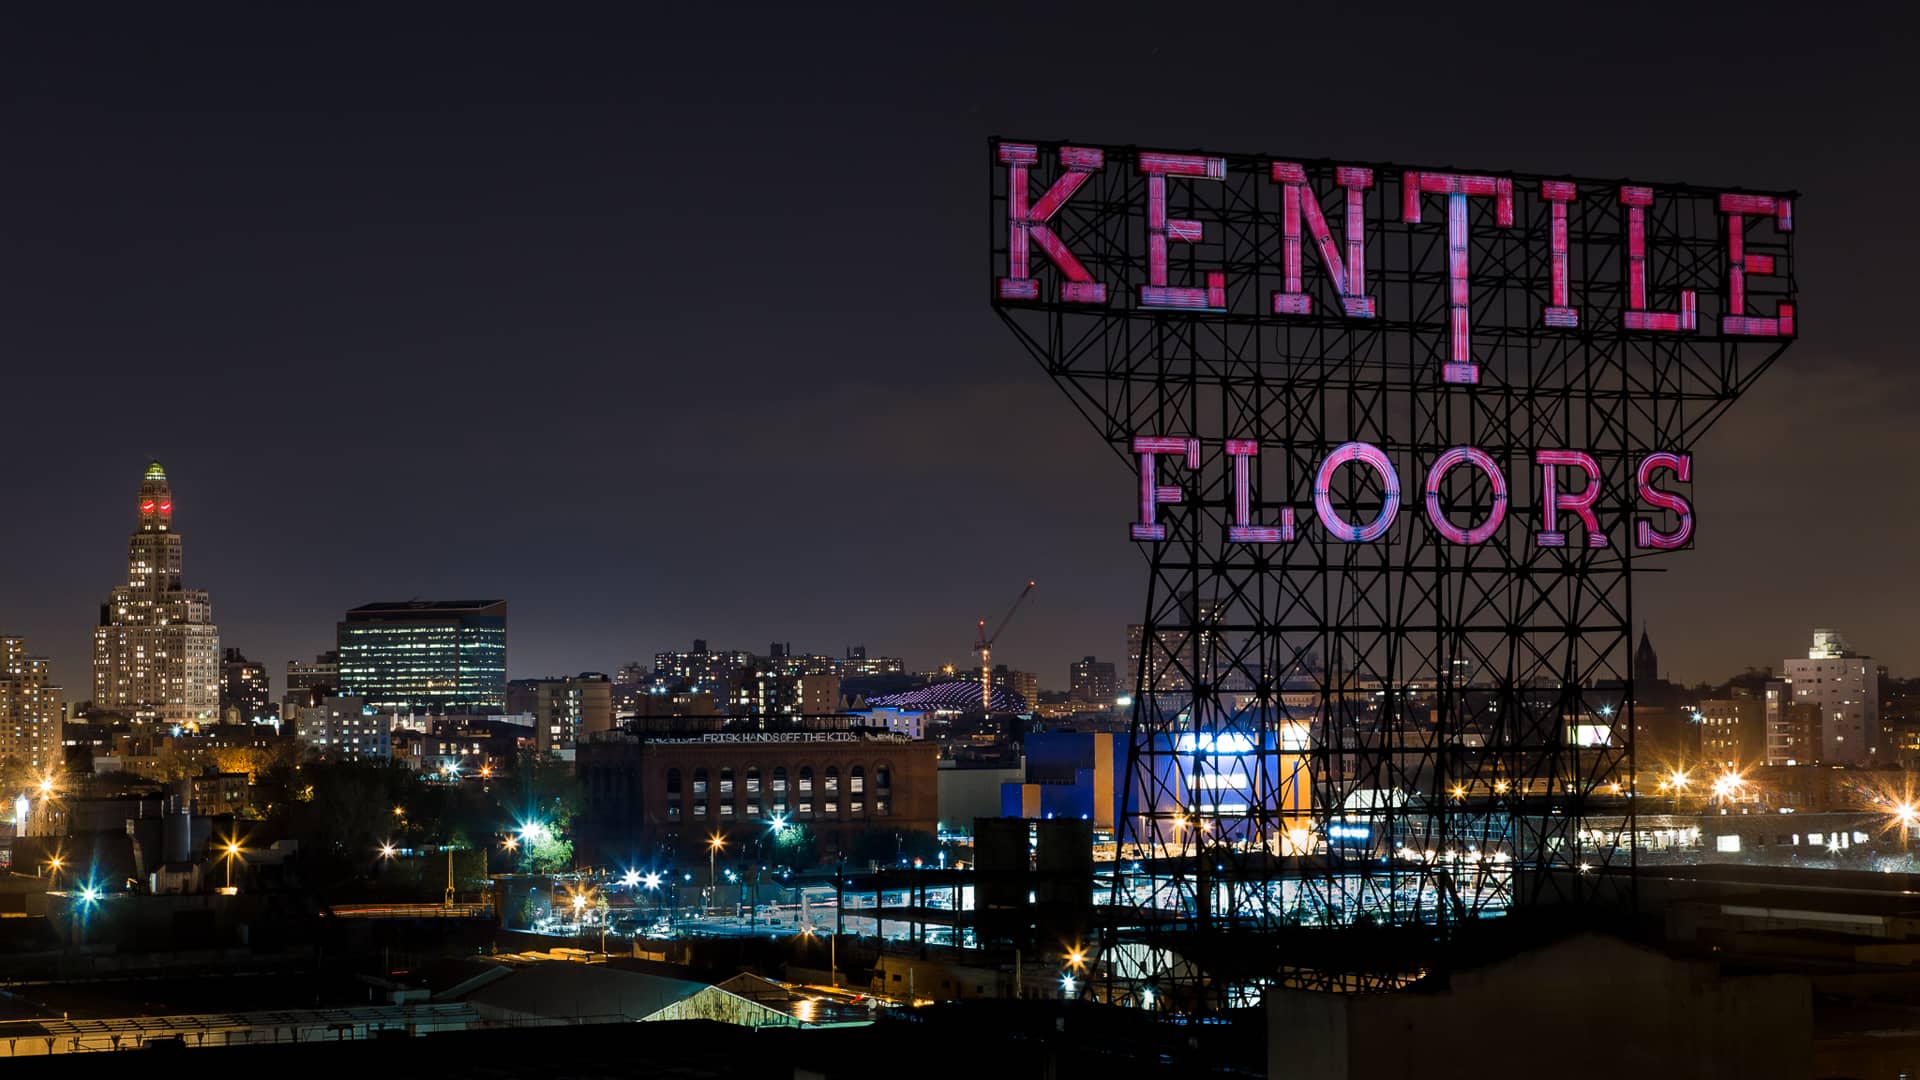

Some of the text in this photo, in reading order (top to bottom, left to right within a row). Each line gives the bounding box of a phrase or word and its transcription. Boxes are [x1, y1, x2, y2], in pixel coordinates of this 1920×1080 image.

[997, 142, 1795, 384] KENTILE
[1130, 435, 1696, 550] FLOORS
[703, 733, 741, 743] FRISK
[742, 733, 779, 743] HANDS
[780, 732, 801, 743] OFF
[802, 732, 827, 743] THE
[827, 731, 857, 743] KIDS
